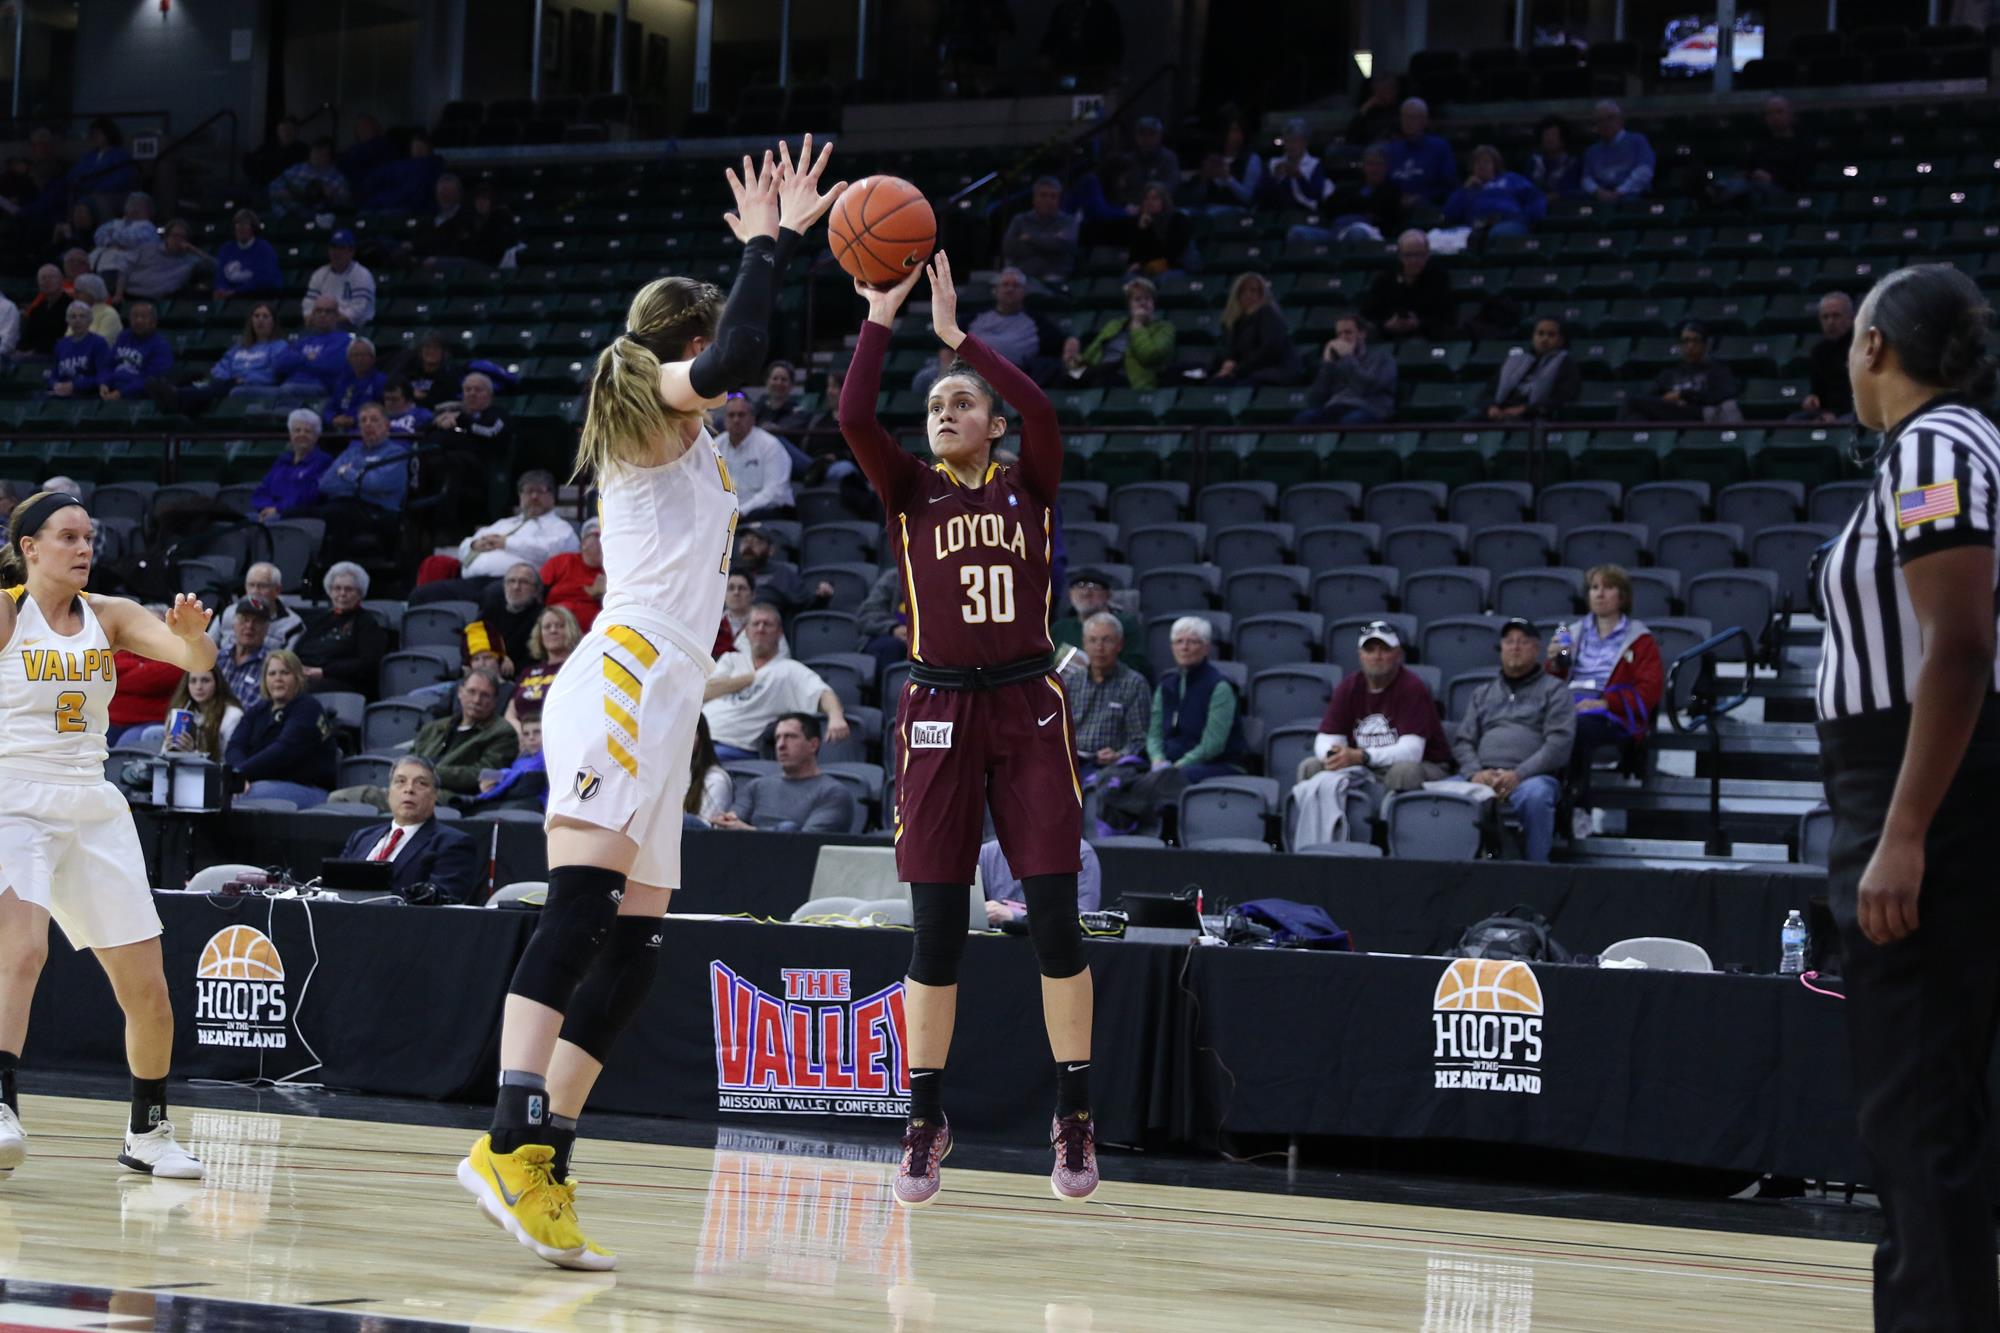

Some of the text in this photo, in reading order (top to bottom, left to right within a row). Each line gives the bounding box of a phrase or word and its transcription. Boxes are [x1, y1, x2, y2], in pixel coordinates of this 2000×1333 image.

[934, 512, 1027, 560] LOYOLA
[959, 564, 1016, 624] 30
[22, 648, 114, 682] VALPO
[55, 690, 88, 734] 2
[914, 724, 952, 746] VALLEY
[194, 980, 287, 1022] HOOPS
[780, 967, 851, 1001] THE
[196, 1029, 287, 1049] HEARTLAND
[226, 1021, 235, 1030] IN
[1431, 1013, 1543, 1063] HOOPS
[1434, 1070, 1542, 1095] HEARTLAND
[718, 1095, 911, 1115] MISSOURI VALLEY CONFERENC
